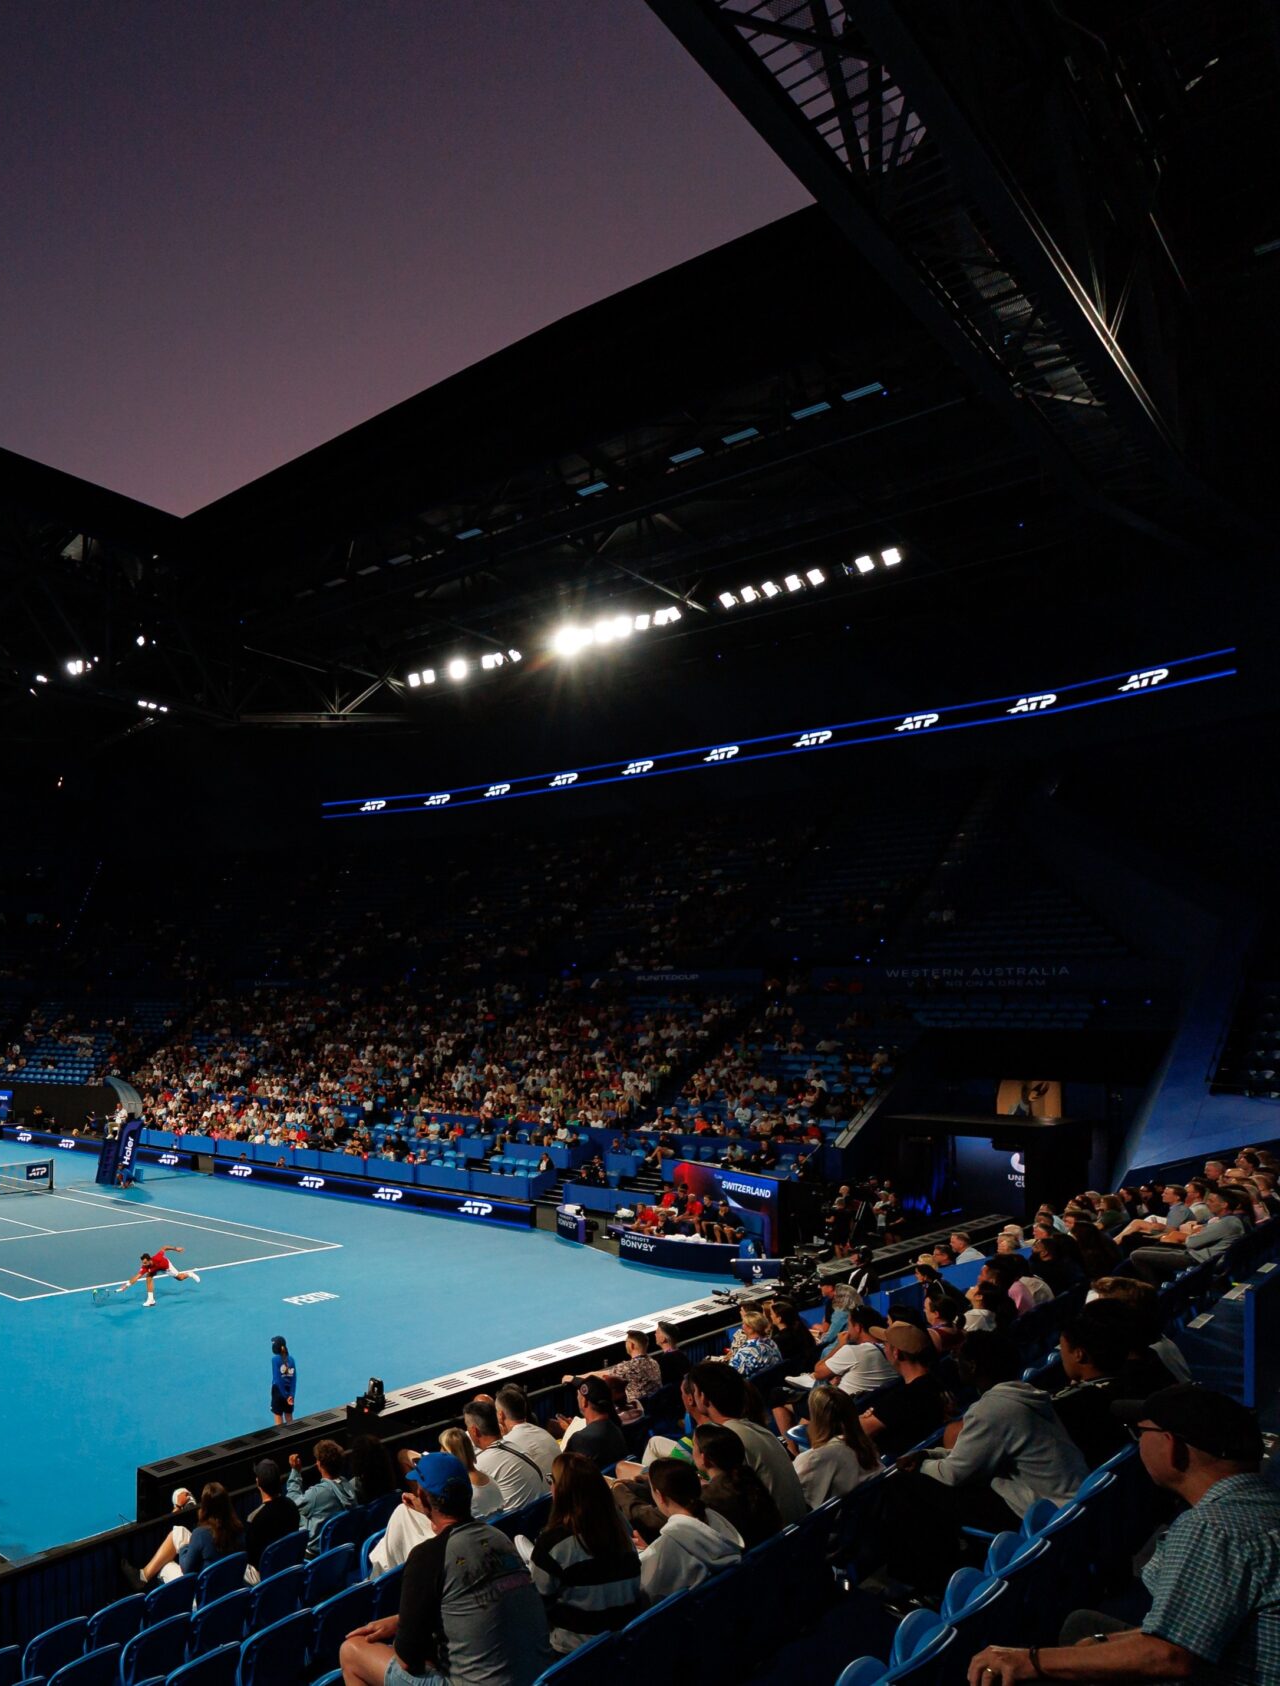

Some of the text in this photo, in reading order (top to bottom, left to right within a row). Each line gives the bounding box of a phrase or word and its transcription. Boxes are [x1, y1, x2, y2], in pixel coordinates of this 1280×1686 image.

[1118, 668, 1169, 692] ATP
[1006, 693, 1057, 714] ATP
[894, 713, 939, 731] ATP
[792, 730, 833, 747] ATP
[704, 745, 740, 762] ATP
[621, 760, 654, 775] ATP
[549, 773, 579, 787] ATP
[484, 784, 511, 797] ATP
[359, 800, 386, 812] ATP
[424, 794, 451, 806] ATP
[885, 965, 1071, 978] WESTERN AUSTRALIA
[16, 1132, 32, 1142] ATP
[58, 1138, 75, 1149] ATP
[122, 1136, 135, 1166] Haier
[157, 1153, 178, 1166] ATP
[28, 1166, 48, 1177] ATP
[228, 1164, 253, 1178] ATP
[298, 1175, 325, 1189] ATP
[372, 1186, 403, 1201] ATP
[721, 1180, 771, 1199] SWITZERLAND
[457, 1200, 493, 1216] ATP
[620, 1238, 655, 1252] BONVOY
[624, 1234, 650, 1243] MARRIOTT
